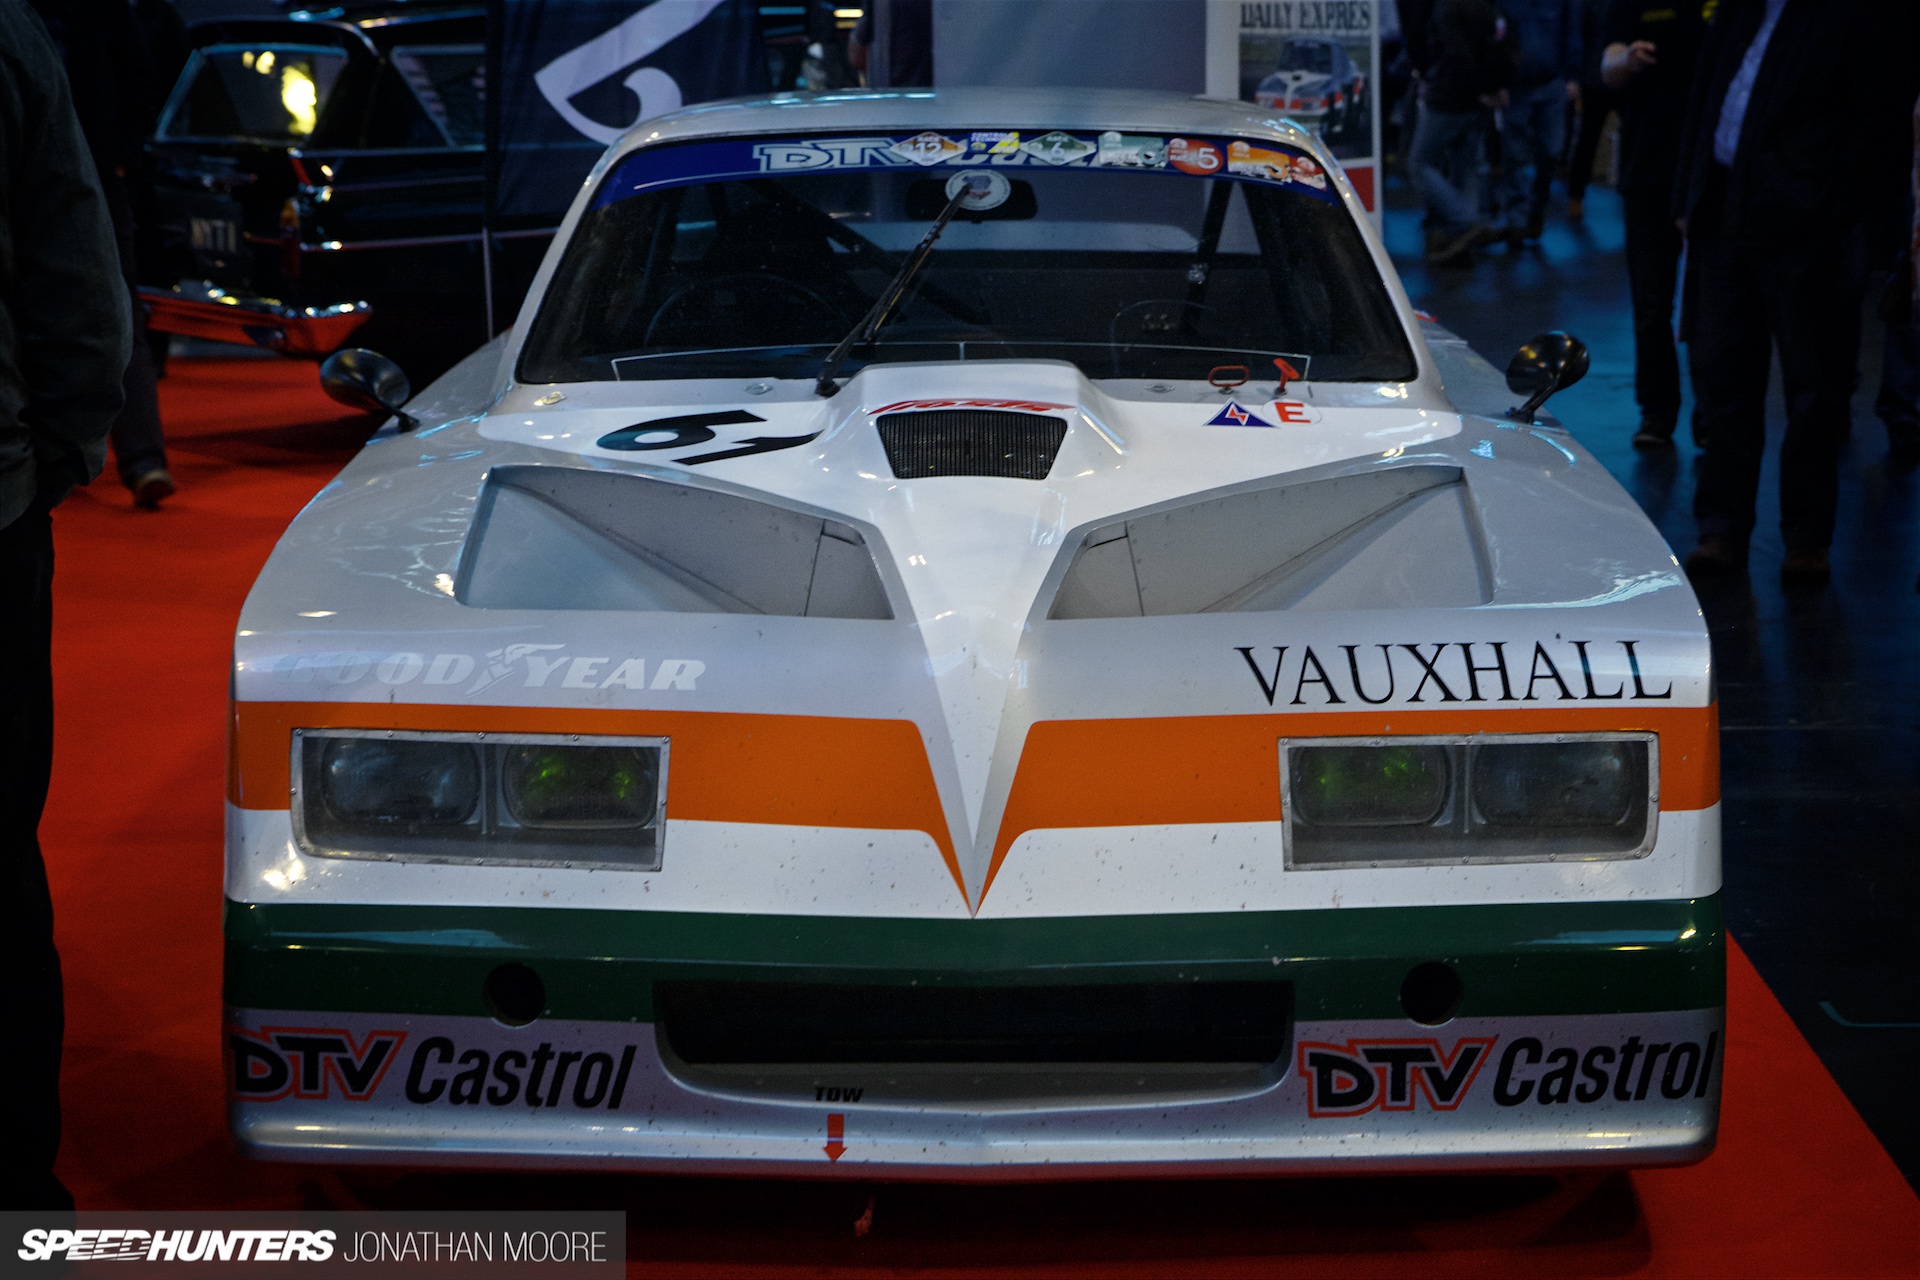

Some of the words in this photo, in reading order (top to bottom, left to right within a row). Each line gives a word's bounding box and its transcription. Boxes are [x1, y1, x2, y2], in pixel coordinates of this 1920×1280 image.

[1240, 3, 1292, 28] DAILY
[1197, 147, 1219, 170] 5
[1234, 641, 1672, 706] VAUXHALL
[230, 1028, 402, 1098] DTV
[405, 1036, 638, 1109] Castrol
[1302, 1039, 1493, 1115] DTV
[1493, 1031, 1718, 1107] Castrol
[815, 1087, 864, 1103] TOW
